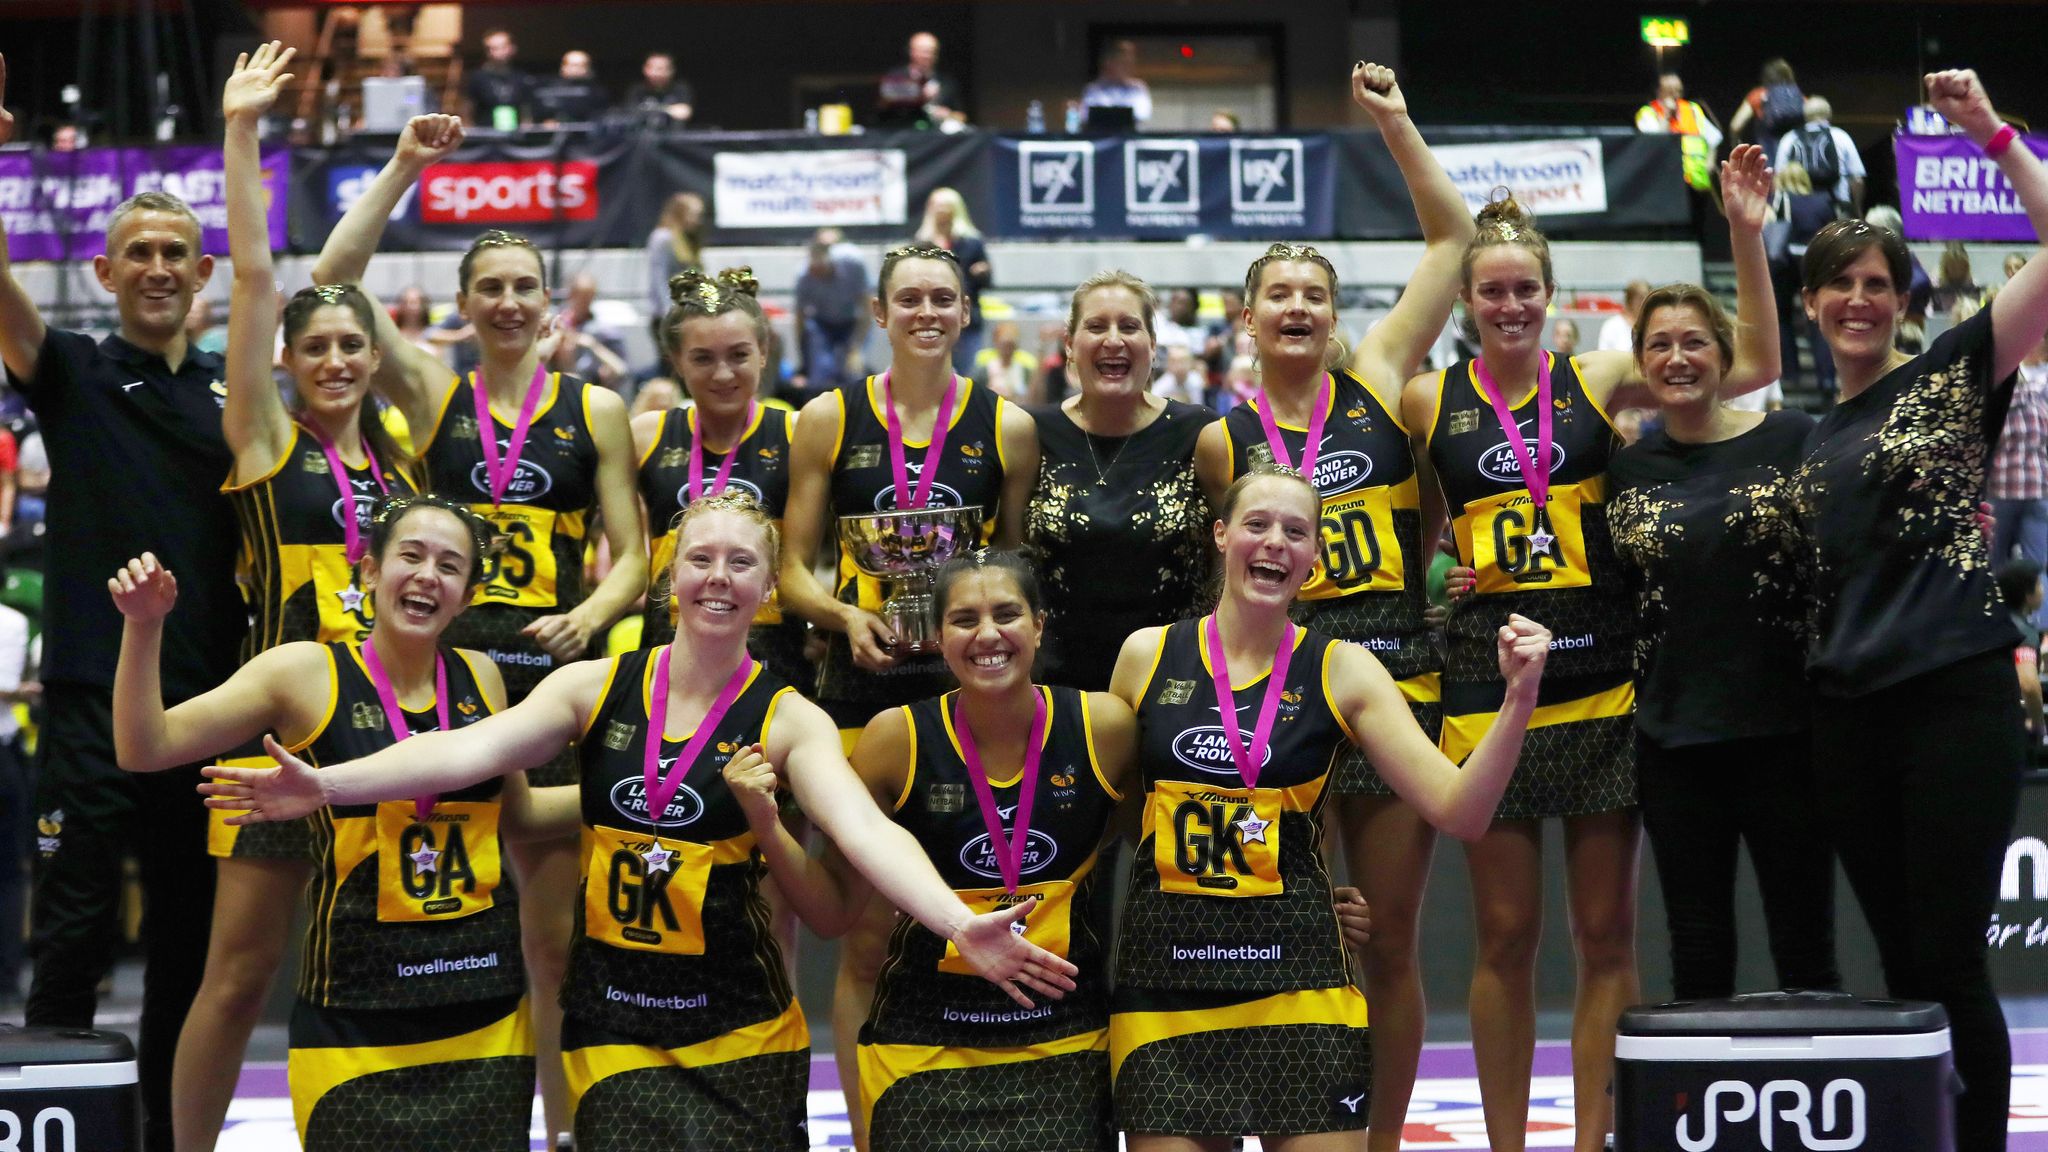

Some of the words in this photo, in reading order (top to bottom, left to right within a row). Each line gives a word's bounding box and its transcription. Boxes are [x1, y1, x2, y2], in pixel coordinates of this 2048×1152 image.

[1446, 160, 1582, 183] atchroom
[1915, 157, 2011, 189] BRIT
[428, 170, 587, 217] sports
[1496, 447, 1536, 462] LAD
[1311, 465, 1358, 488] ROVER
[1312, 460, 1342, 478] AND
[1321, 509, 1383, 580] GD
[1493, 508, 1569, 576] GA
[1549, 633, 1594, 650] etball
[1192, 733, 1230, 750] LAN
[1173, 800, 1255, 876] GK
[400, 822, 477, 899] GA
[608, 848, 682, 932] GK
[397, 952, 499, 978] lovellnetball
[1173, 945, 1281, 961] lovellnetball
[606, 985, 707, 1009] lovellnetball
[943, 1005, 1052, 1023] lovellnetball
